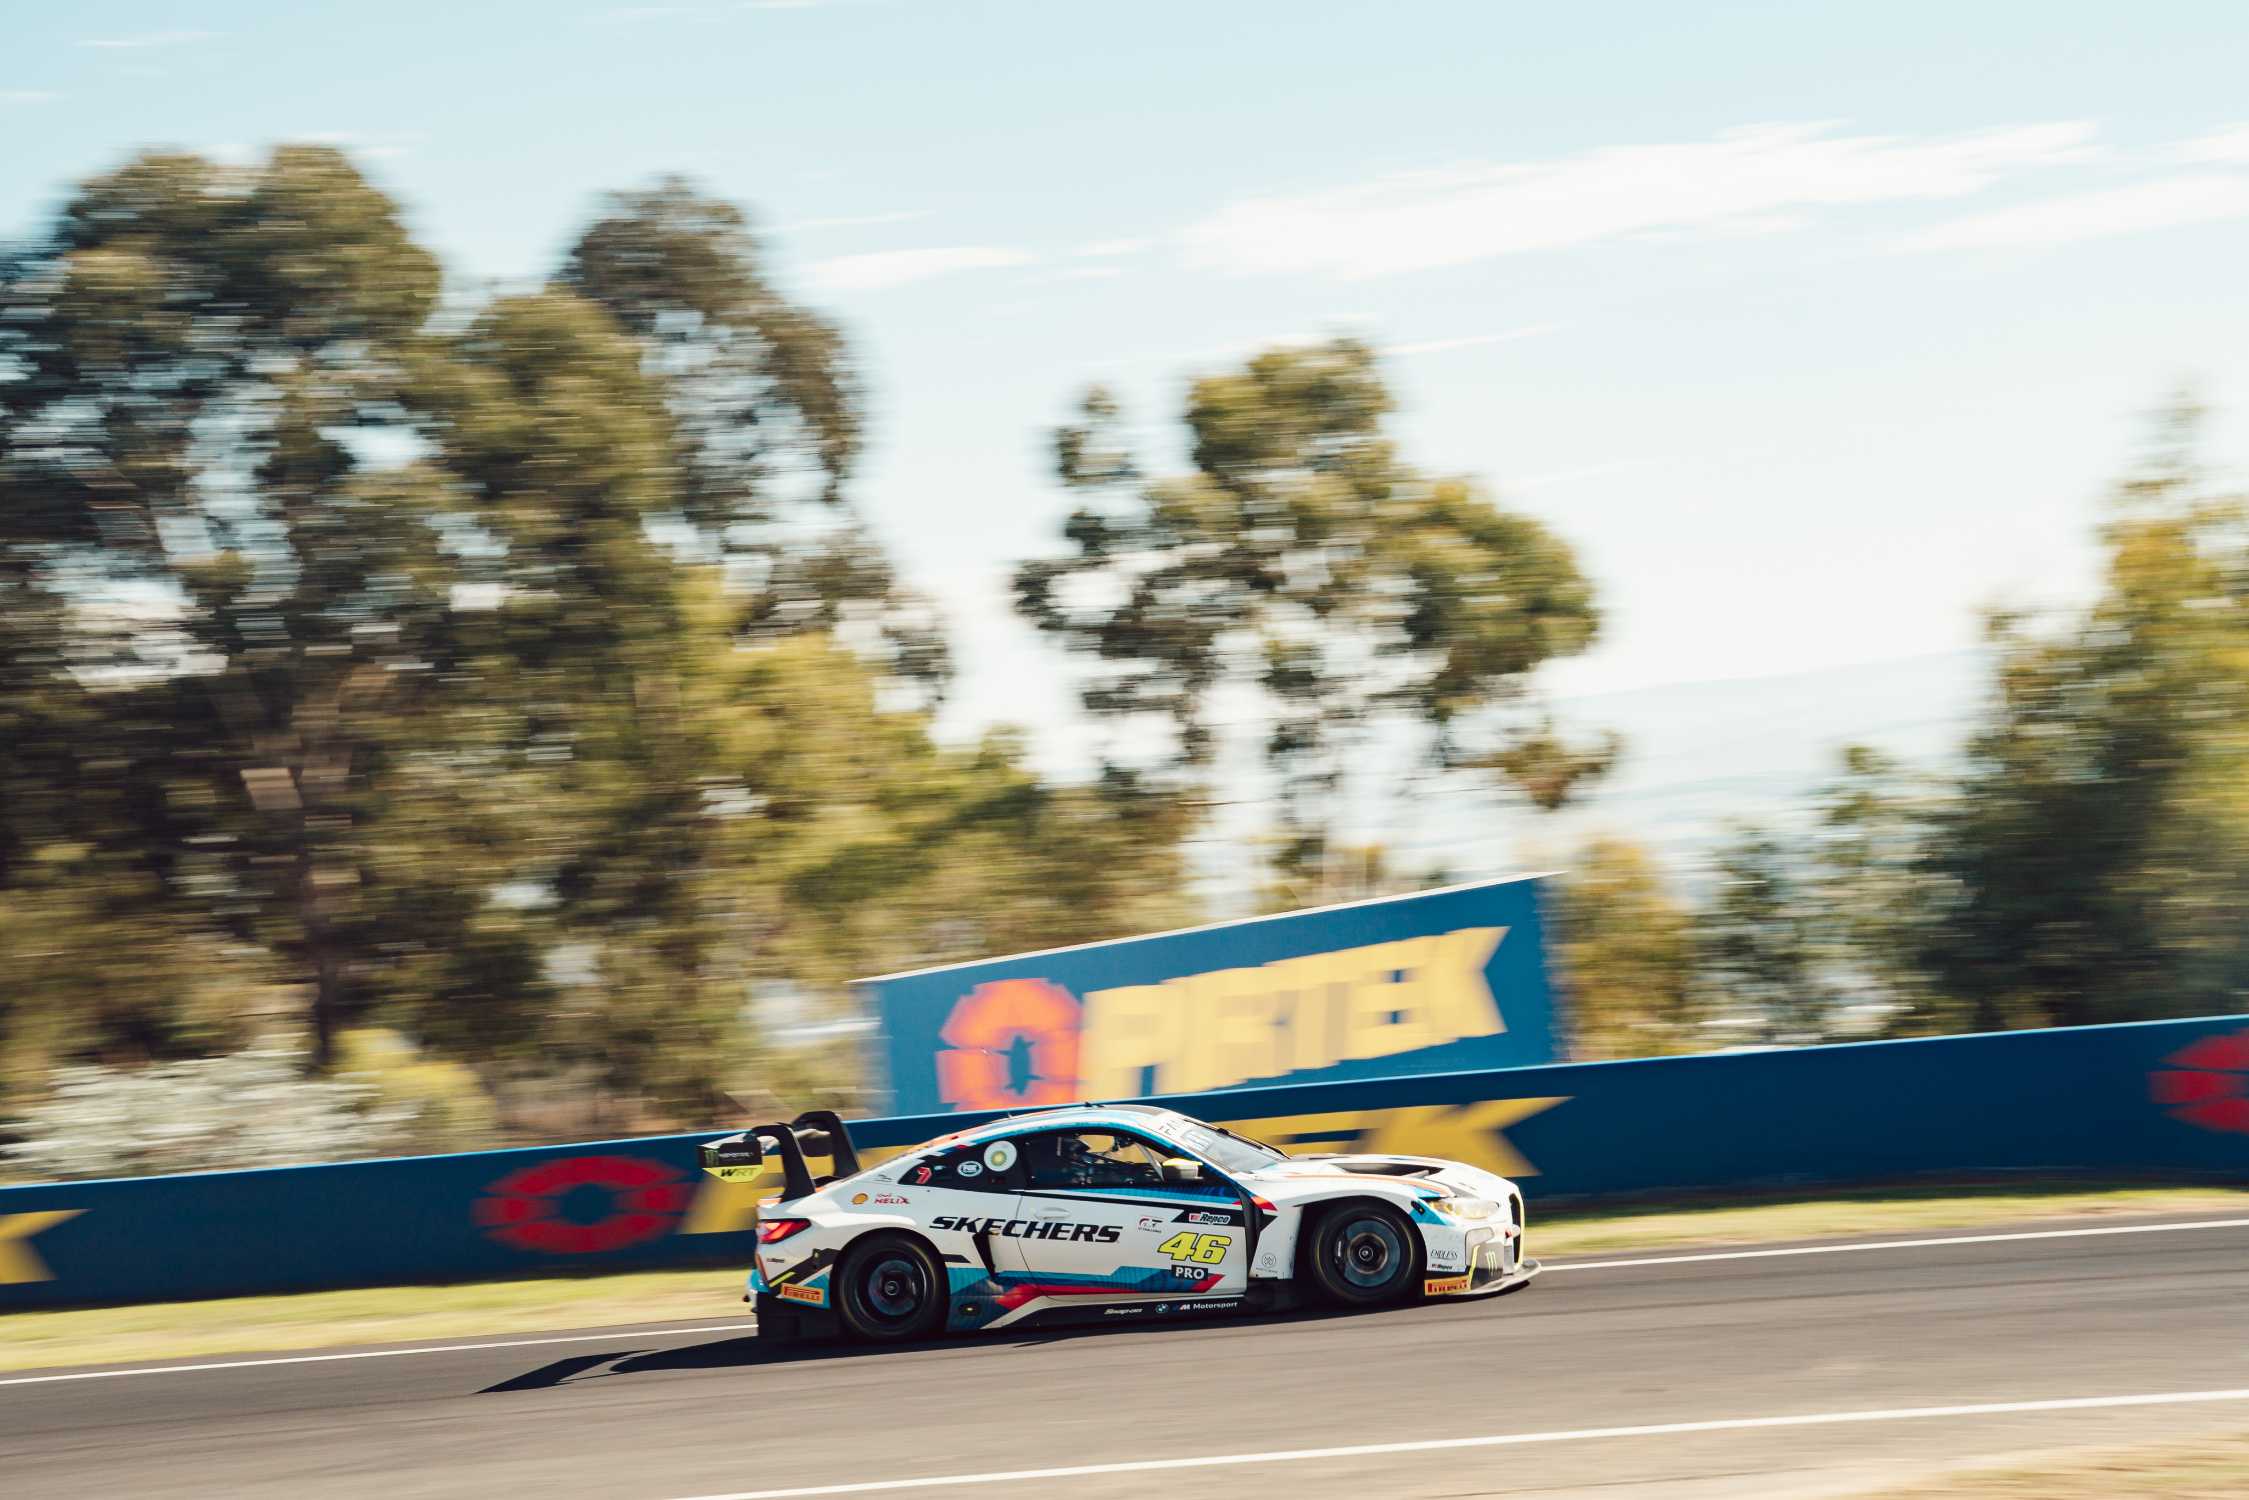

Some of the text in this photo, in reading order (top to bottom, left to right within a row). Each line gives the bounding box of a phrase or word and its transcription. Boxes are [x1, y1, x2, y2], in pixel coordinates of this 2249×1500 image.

[1200, 1212, 1231, 1224] Repco
[929, 1216, 1123, 1243] SKECHERS
[1157, 1231, 1232, 1265] 46
[1175, 1266, 1205, 1279] PRO
[1193, 1302, 1239, 1310] Motorsport
